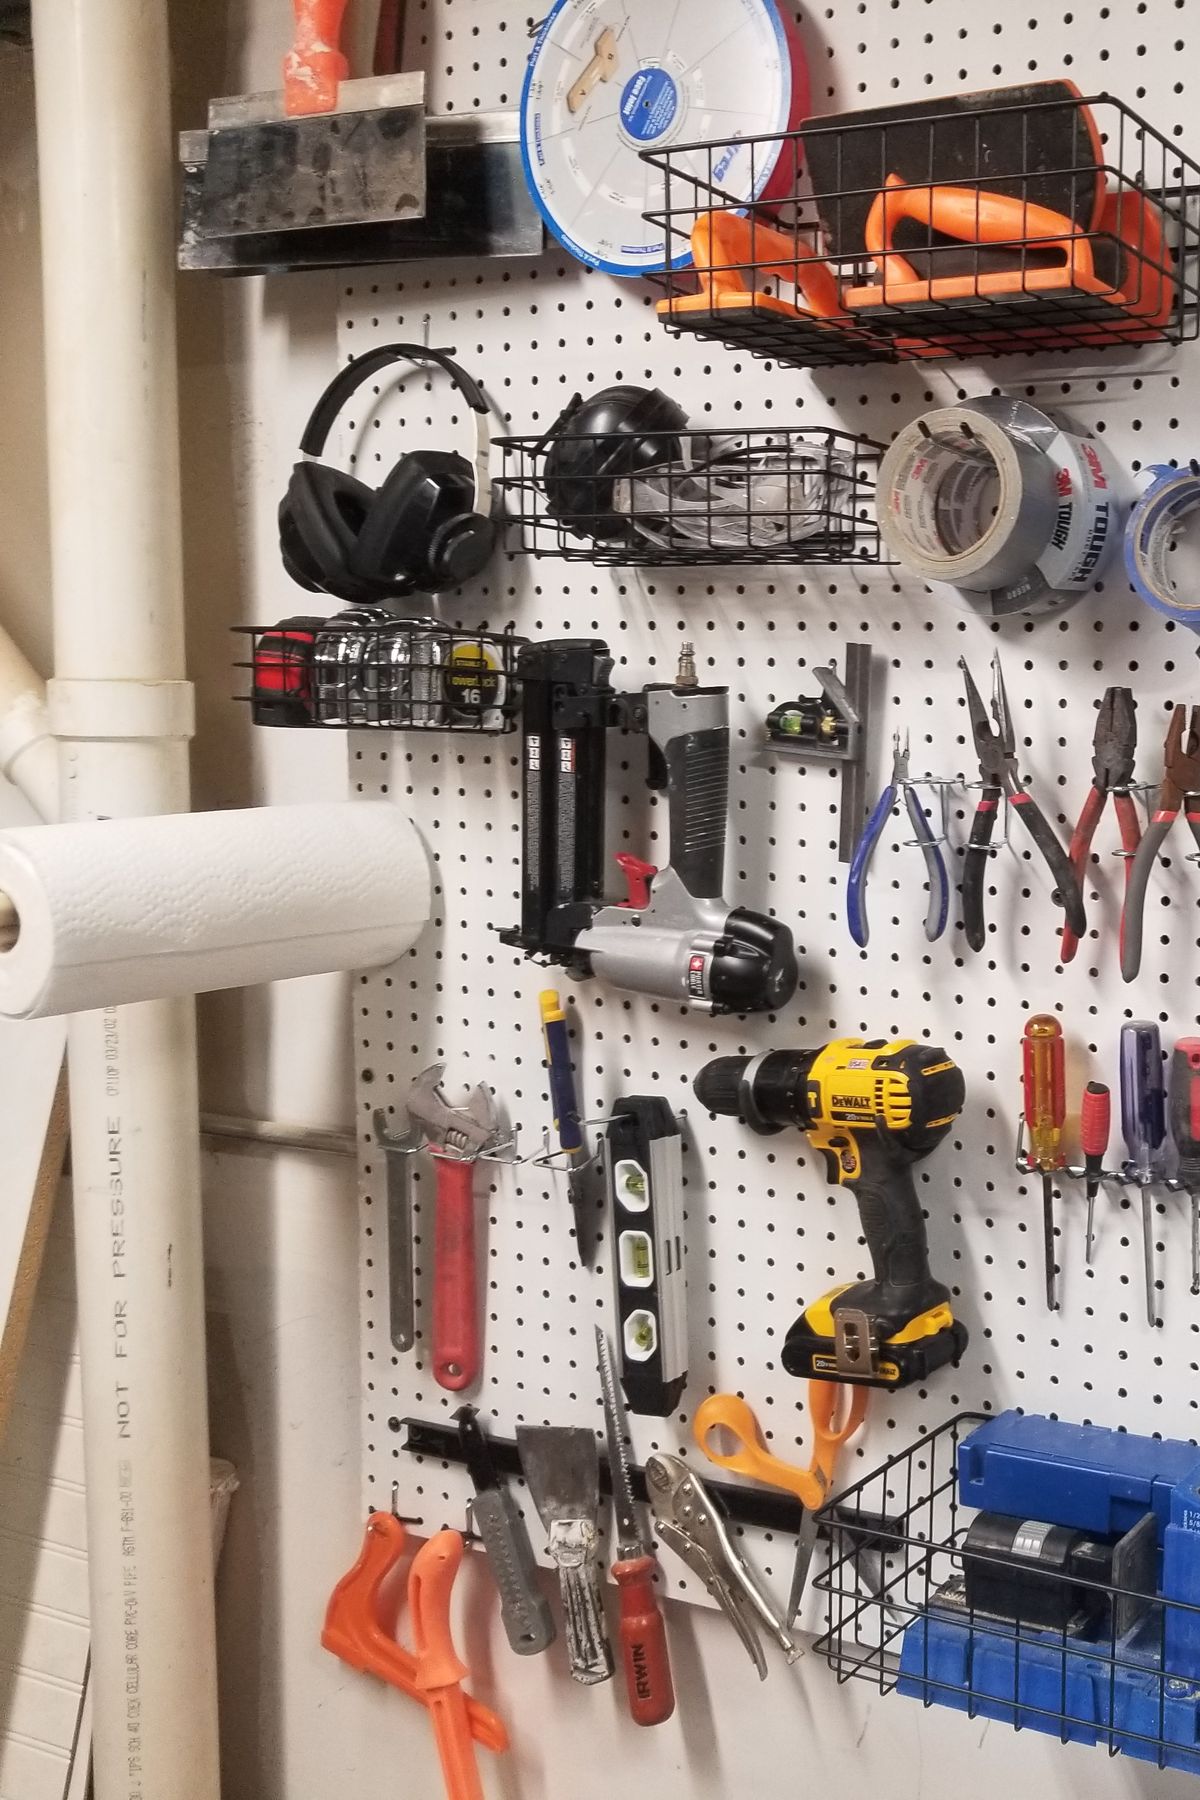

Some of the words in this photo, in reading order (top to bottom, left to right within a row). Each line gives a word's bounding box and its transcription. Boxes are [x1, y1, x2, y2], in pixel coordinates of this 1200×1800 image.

[1056, 468, 1073, 497] 3M
[1080, 443, 1108, 490] 3M
[1051, 502, 1073, 551] TOUGH
[1072, 502, 1109, 583] TOUGH
[461, 688, 481, 704] 16
[832, 1095, 871, 1109] DEWALT
[107, 1115, 127, 1278] PRESSURE
[113, 1300, 128, 1358] FOR
[115, 1381, 131, 1439] NOT
[1188, 1519, 1200, 1528] 5/8
[1189, 1510, 1200, 1520] 1/2
[126, 1653, 140, 1696] CELLULAR
[632, 1643, 651, 1699] IRWIN
